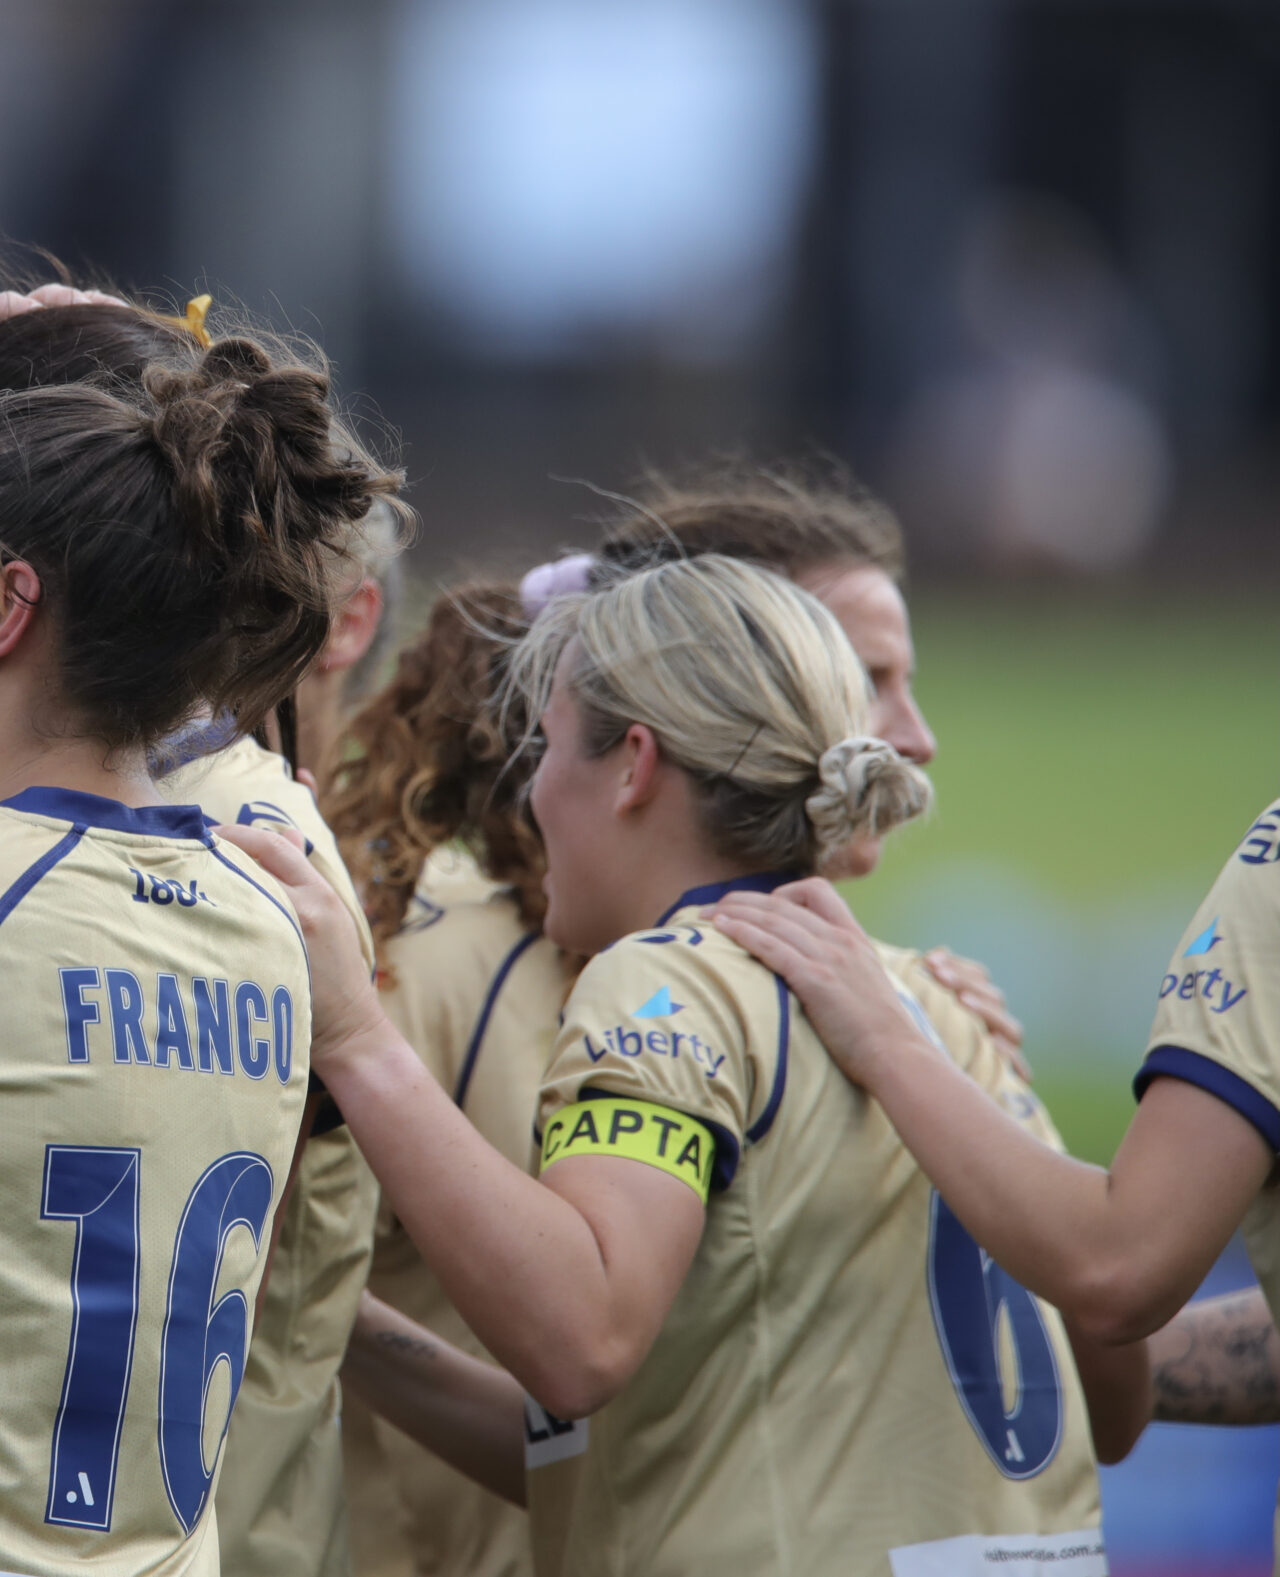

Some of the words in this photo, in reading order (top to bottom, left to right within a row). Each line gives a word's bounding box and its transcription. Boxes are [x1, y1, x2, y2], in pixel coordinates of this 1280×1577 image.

[58, 966, 294, 1086] FRANCO
[584, 1026, 726, 1079] Liberty
[40, 1143, 275, 1540] 16
